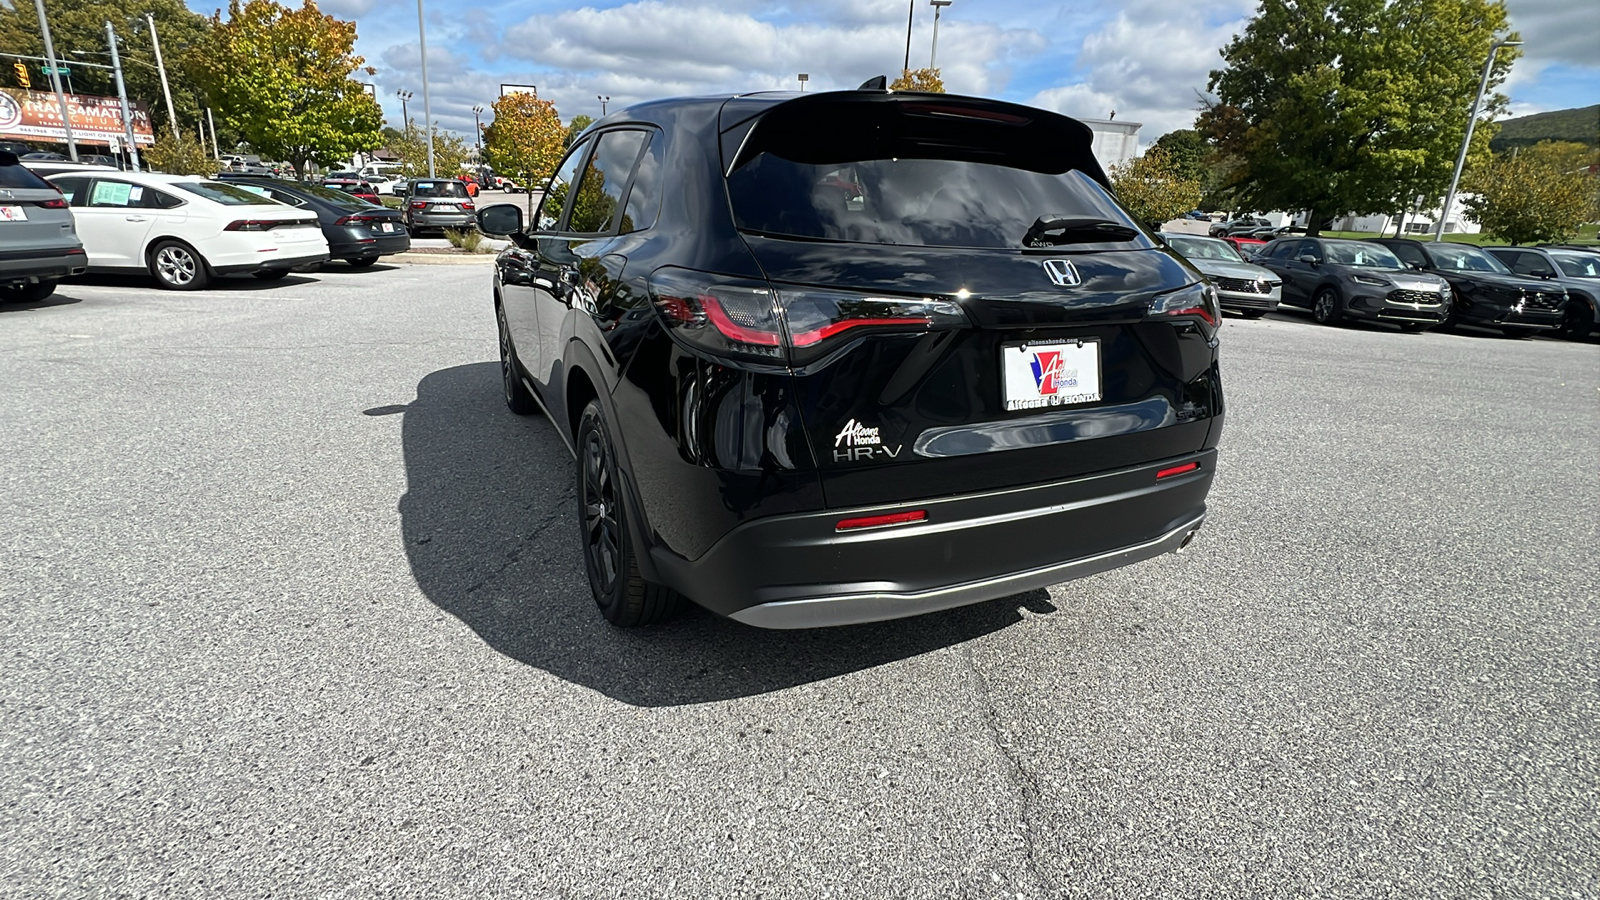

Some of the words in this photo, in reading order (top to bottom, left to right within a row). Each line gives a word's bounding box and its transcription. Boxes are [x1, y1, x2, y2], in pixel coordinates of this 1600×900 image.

[1028, 338, 1078, 346] altoonahonda.com
[1054, 378, 1077, 388] Honda
[1007, 398, 1048, 411] Altoona
[1064, 393, 1101, 405] HONDA
[835, 418, 879, 447] Altoona
[854, 435, 881, 446] Honda
[833, 444, 902, 463] HR-V
